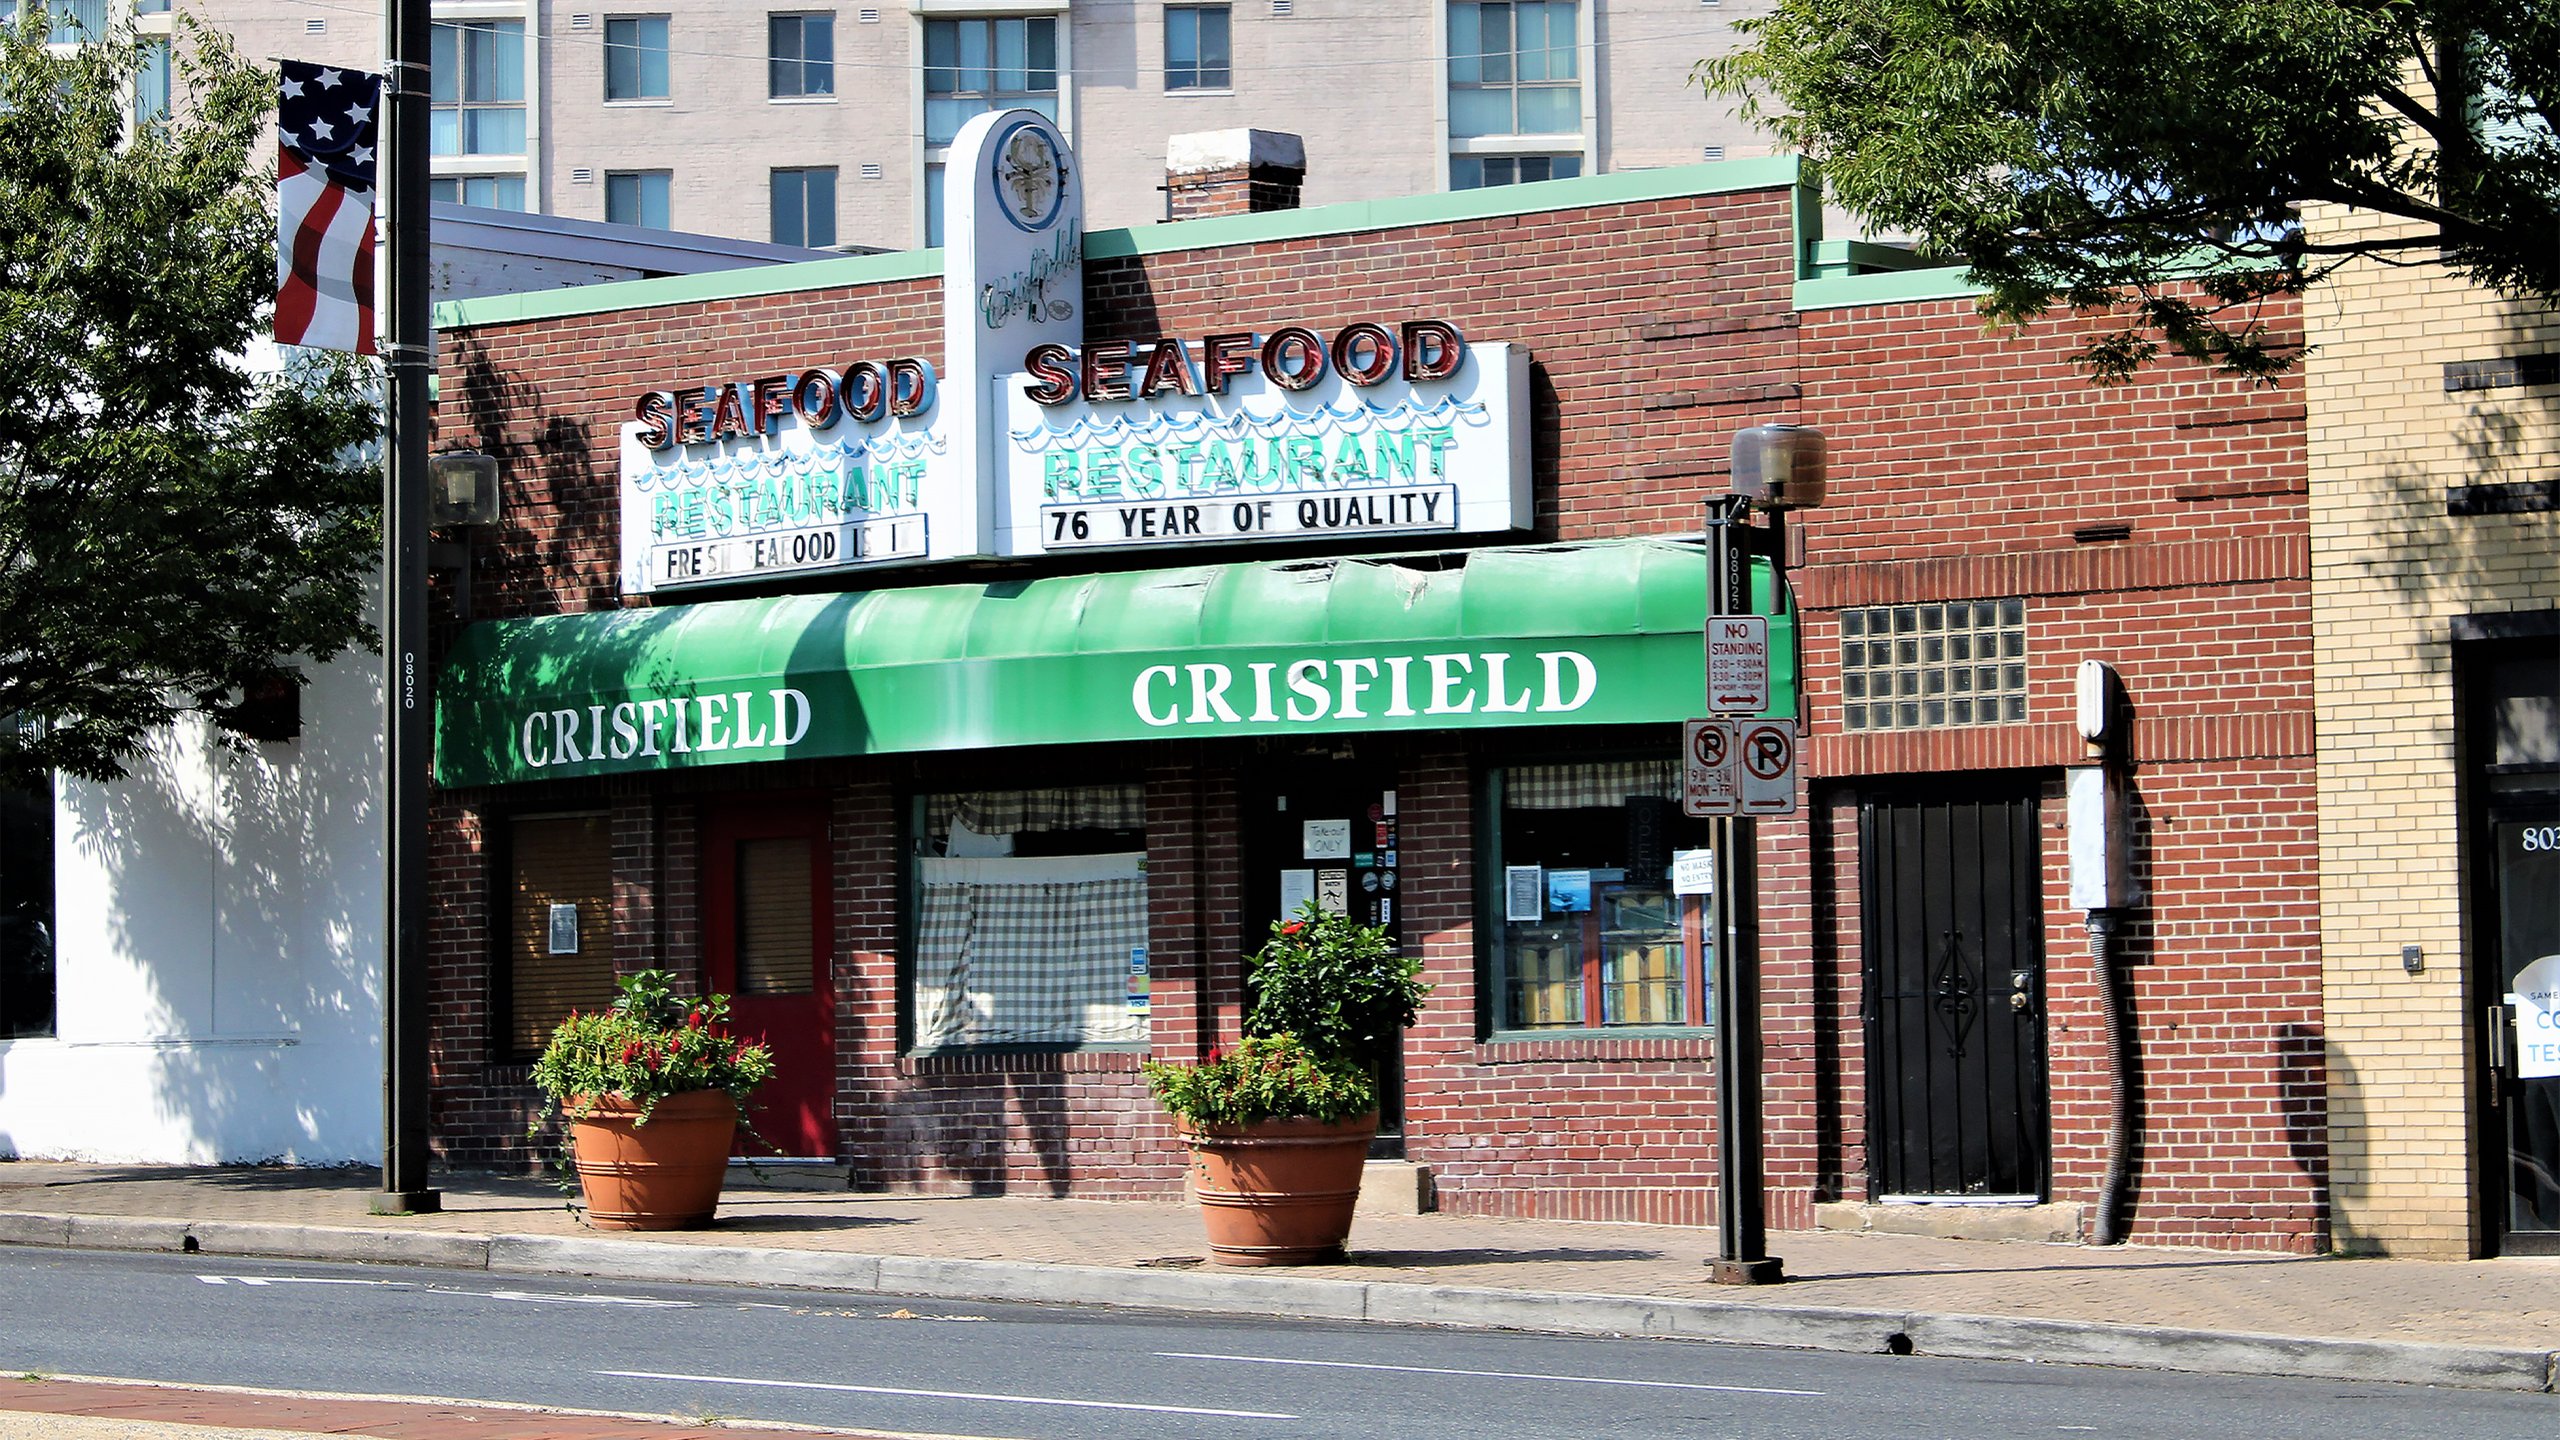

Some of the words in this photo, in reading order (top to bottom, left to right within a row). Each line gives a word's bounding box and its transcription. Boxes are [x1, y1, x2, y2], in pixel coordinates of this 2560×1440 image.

[1024, 320, 1465, 406] SEAFOOD
[635, 356, 938, 451] SEAFOOD
[1044, 427, 1455, 500] RESTAURANT
[652, 459, 927, 539] RESTAURANT
[1052, 511, 1089, 541] 76
[1120, 505, 1201, 537] YEAR
[1233, 501, 1273, 532] OF
[1297, 492, 1442, 527] QUALITY
[1729, 546, 1740, 610] 08022
[1712, 642, 1763, 655] STANDING
[1725, 623, 1748, 638] NO
[405, 652, 415, 709] 08020
[1131, 649, 1598, 727] CRISFIELD
[523, 688, 812, 767] CRISFIELD
[1689, 785, 1709, 796] MON
[1720, 785, 1734, 796] FRI
[1314, 839, 1342, 852] ONLY
[1680, 863, 1690, 871] NO
[1681, 875, 1691, 883] NO
